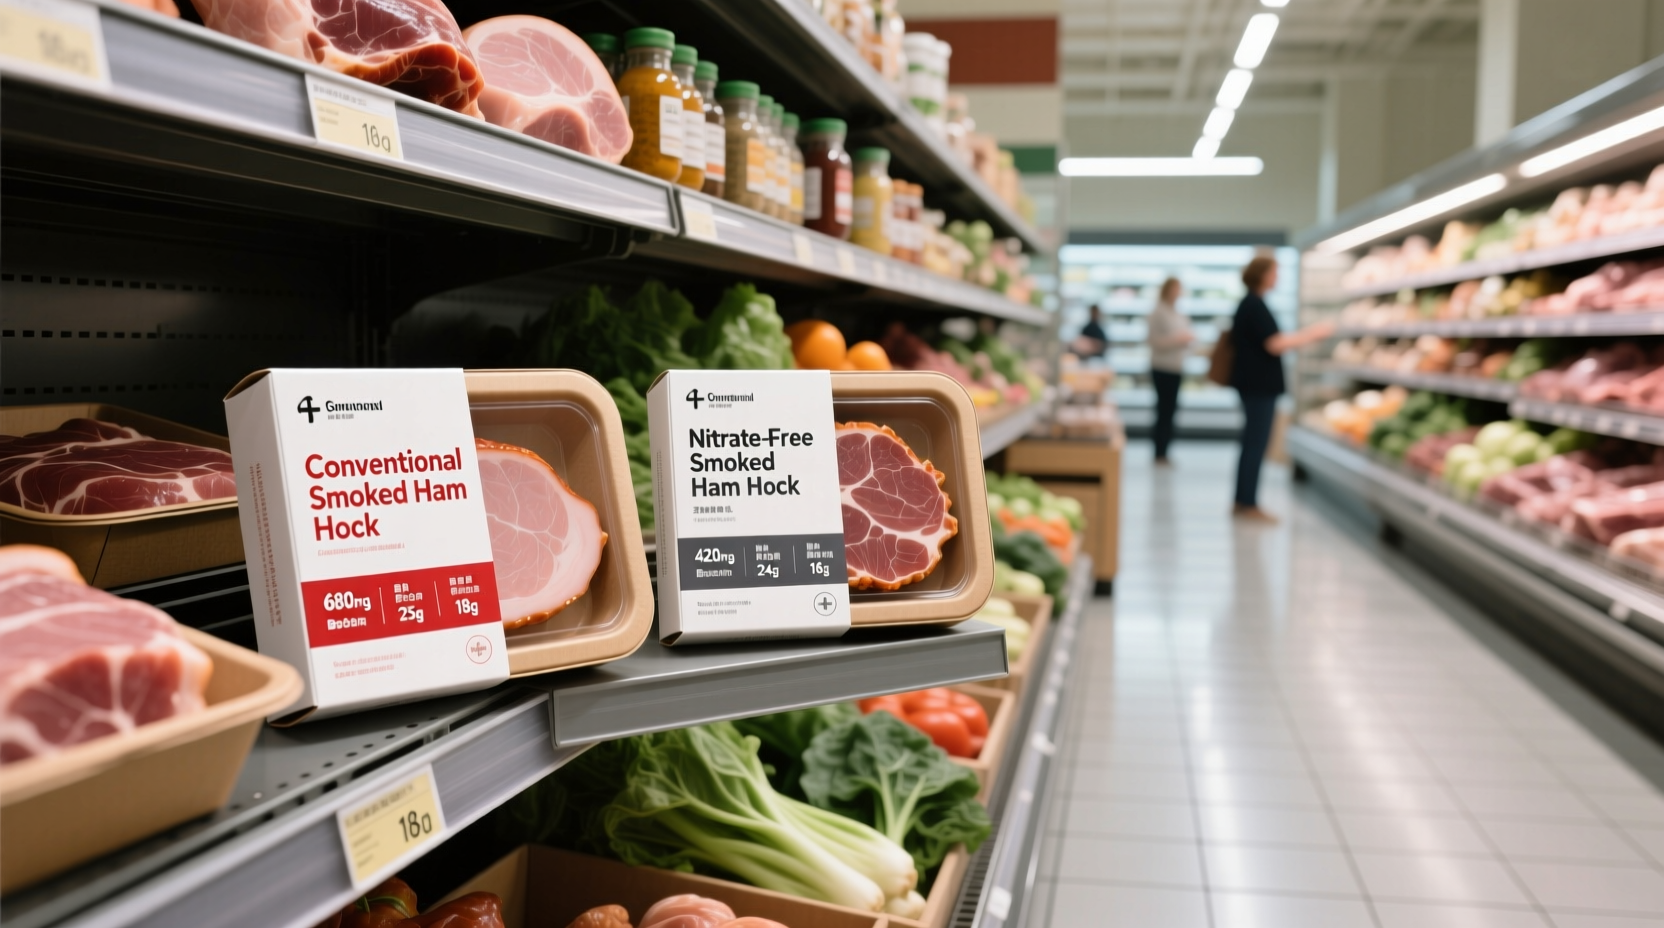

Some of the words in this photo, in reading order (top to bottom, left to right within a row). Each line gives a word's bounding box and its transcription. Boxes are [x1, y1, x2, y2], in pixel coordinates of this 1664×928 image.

[689, 428, 814, 448] Nitrate-Free
[305, 447, 462, 479] Conventional
[690, 451, 775, 472] Smoked
[309, 480, 408, 510] Smoked
[413, 479, 468, 503] Ham
[692, 477, 741, 497] Ham
[747, 475, 801, 496] Hock
[314, 512, 381, 541] Hock
[756, 564, 779, 578] 24g
[809, 562, 830, 577] 16g
[397, 605, 424, 623] 25g
[455, 598, 479, 616] 18g
